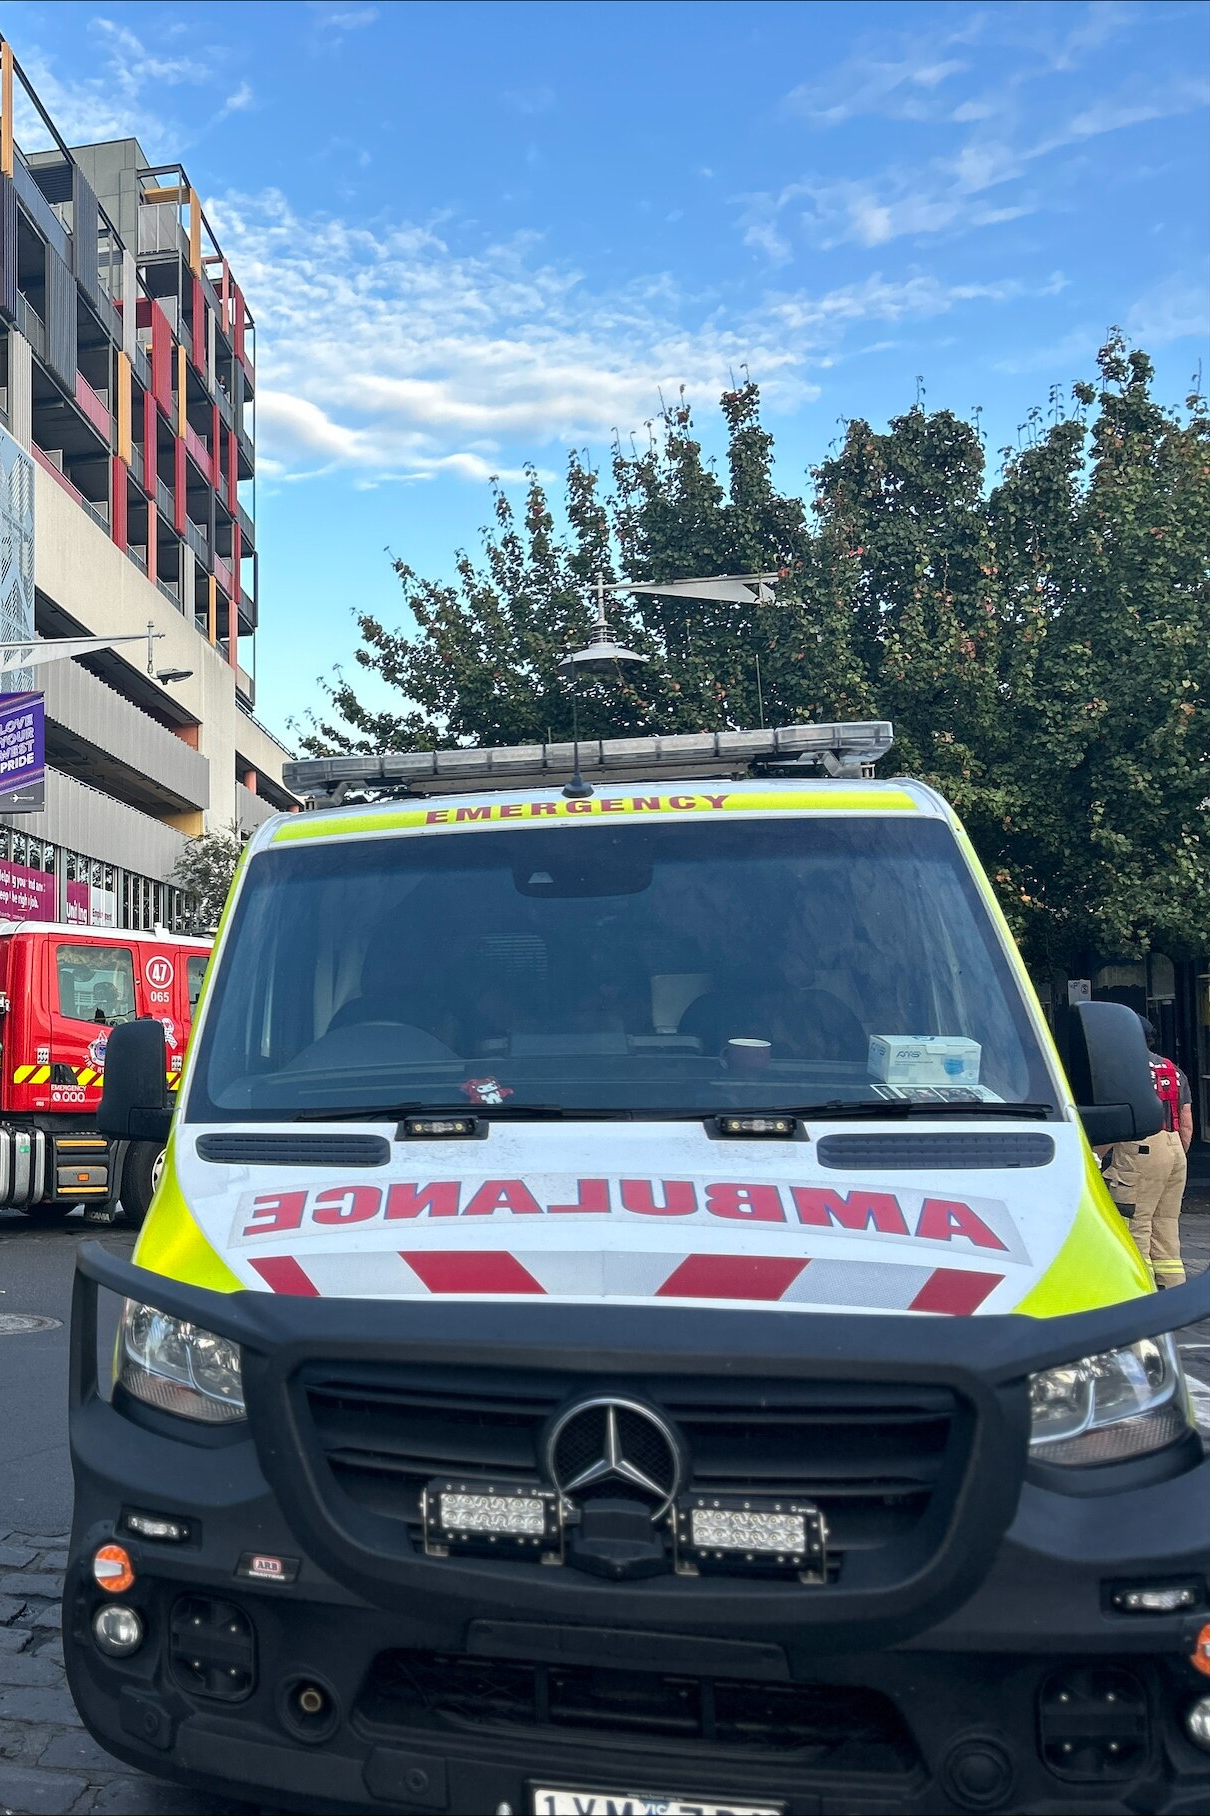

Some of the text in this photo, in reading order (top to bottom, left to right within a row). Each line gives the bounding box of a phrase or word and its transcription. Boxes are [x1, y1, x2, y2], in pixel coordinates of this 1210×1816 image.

[0, 752, 35, 774] PRIDE
[425, 794, 730, 825] EMERGENCY
[152, 963, 167, 982] 47
[150, 991, 170, 1003] 065
[51, 1084, 87, 1092] EMERGENCY
[62, 1091, 86, 1103] 000
[257, 1560, 278, 1571] ARB
